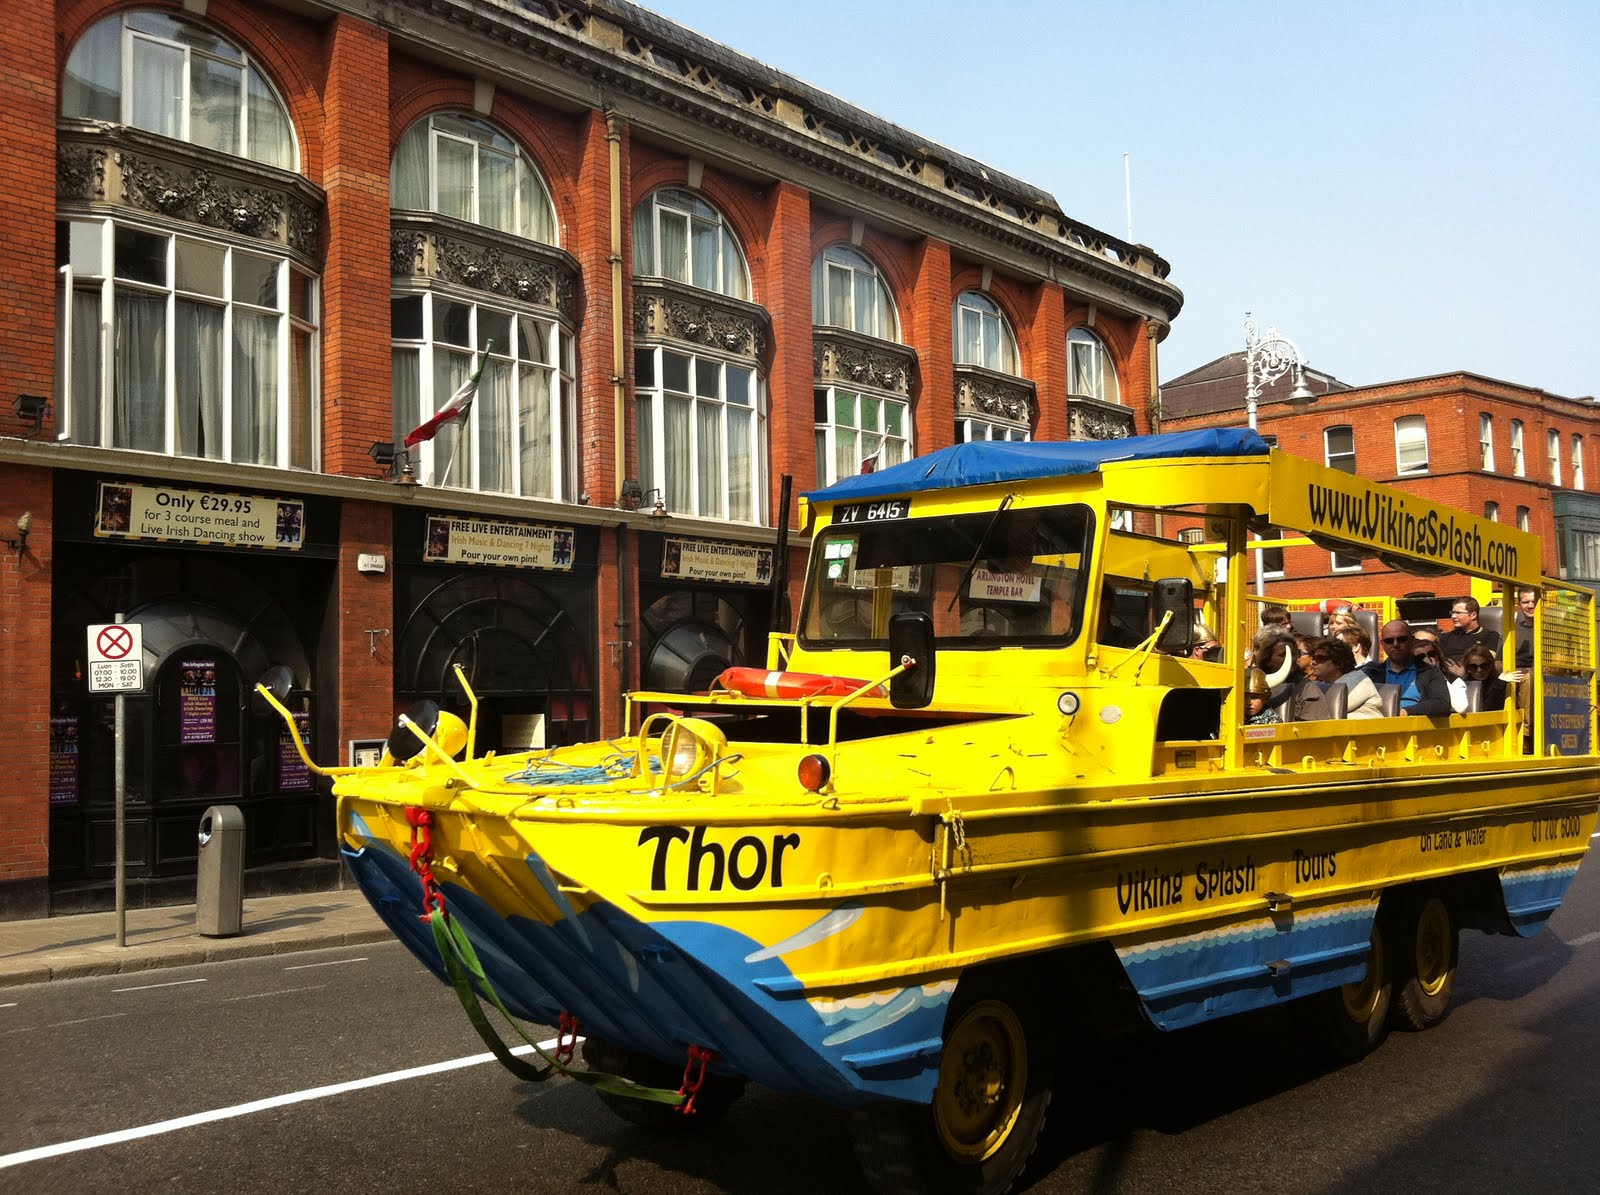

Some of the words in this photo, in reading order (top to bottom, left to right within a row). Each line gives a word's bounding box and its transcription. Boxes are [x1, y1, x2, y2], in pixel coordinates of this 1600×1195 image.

[156, 493, 194, 512] Only
[200, 495, 251, 513] €29.95
[841, 506, 860, 522] ZV
[868, 502, 900, 520] 6415
[144, 509, 161, 520] for
[165, 511, 170, 520] 3
[175, 514, 211, 524] course
[215, 515, 238, 526] meal
[242, 519, 260, 528] and
[141, 523, 162, 534] Live
[167, 525, 189, 537] Irish
[194, 528, 235, 542] Dancing
[238, 530, 265, 542] show
[452, 522, 469, 532] FREE
[472, 524, 488, 533] LIVE
[490, 525, 552, 539] ENTERTAINMENT
[1309, 483, 1518, 578] www.VikingSplash.com
[452, 535, 466, 544] Irish
[468, 536, 488, 546] Music
[496, 539, 523, 551] Dancing
[531, 542, 551, 553] Nights
[683, 543, 696, 552] FREE
[698, 544, 709, 553] LIVE
[711, 545, 756, 558] ENTERTAINMENT
[462, 550, 480, 559] Pour
[482, 553, 500, 561] your
[521, 554, 538, 564] pint!
[716, 558, 735, 568] Dancing
[740, 560, 755, 569] Nights
[976, 570, 1014, 583] ARLINGTON
[1016, 574, 1034, 584] HOTEL
[987, 585, 1009, 596] TEMPLE
[1011, 586, 1024, 597] BAR
[1420, 834, 1432, 852] On
[1434, 831, 1452, 850] Land
[1455, 834, 1461, 848] &
[1465, 829, 1486, 846] Water
[638, 825, 800, 891] Thor
[1117, 867, 1184, 916] Viking
[1195, 856, 1256, 901] Splash
[1293, 848, 1337, 884] Tours
